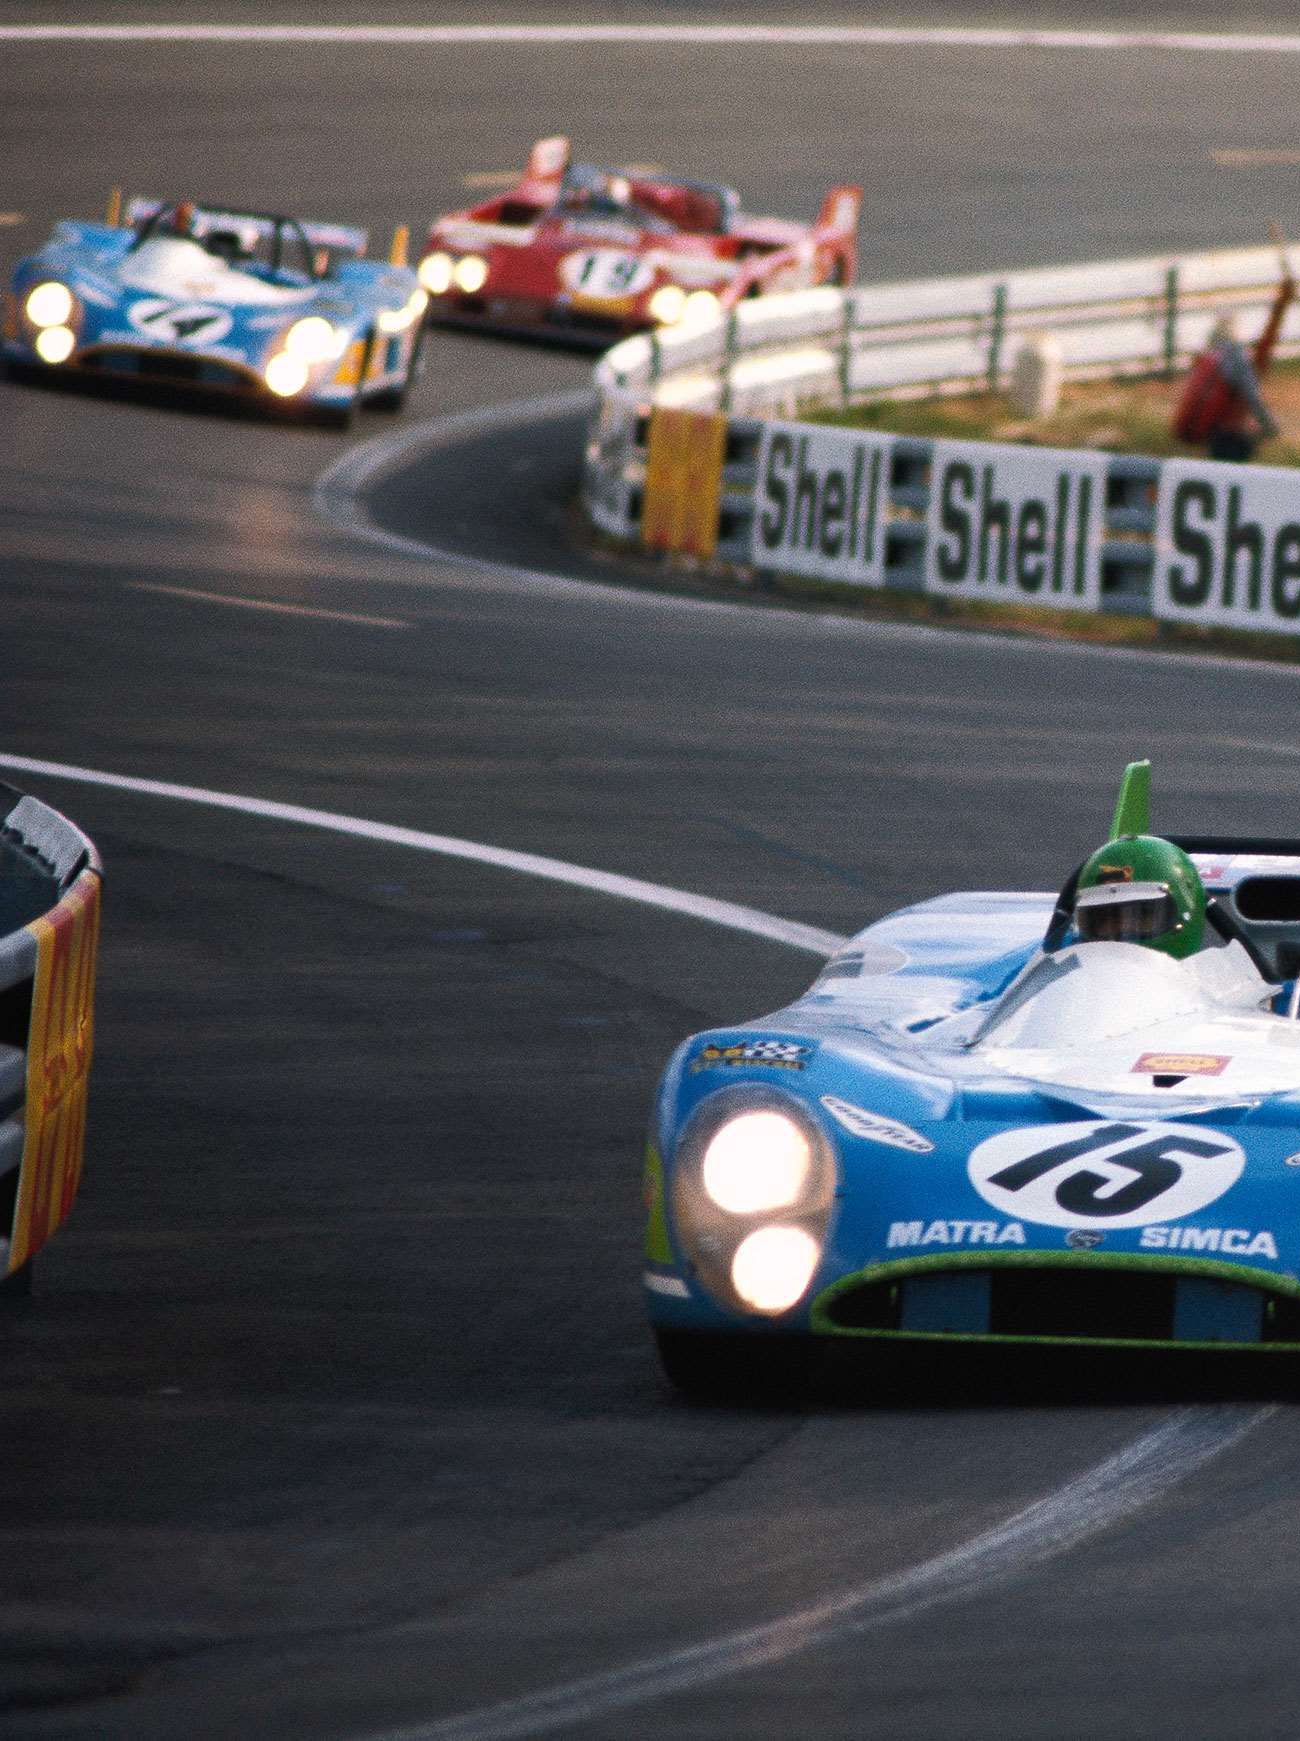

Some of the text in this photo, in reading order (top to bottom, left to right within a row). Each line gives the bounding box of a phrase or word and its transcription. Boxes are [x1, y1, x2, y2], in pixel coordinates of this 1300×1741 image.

[580, 254, 640, 292] 19
[762, 433, 881, 563] Shell
[937, 462, 1090, 597] Shell
[987, 1123, 1234, 1217] 15
[887, 1221, 1026, 1248] MATRA
[1140, 1226, 1278, 1260] SIMCA
